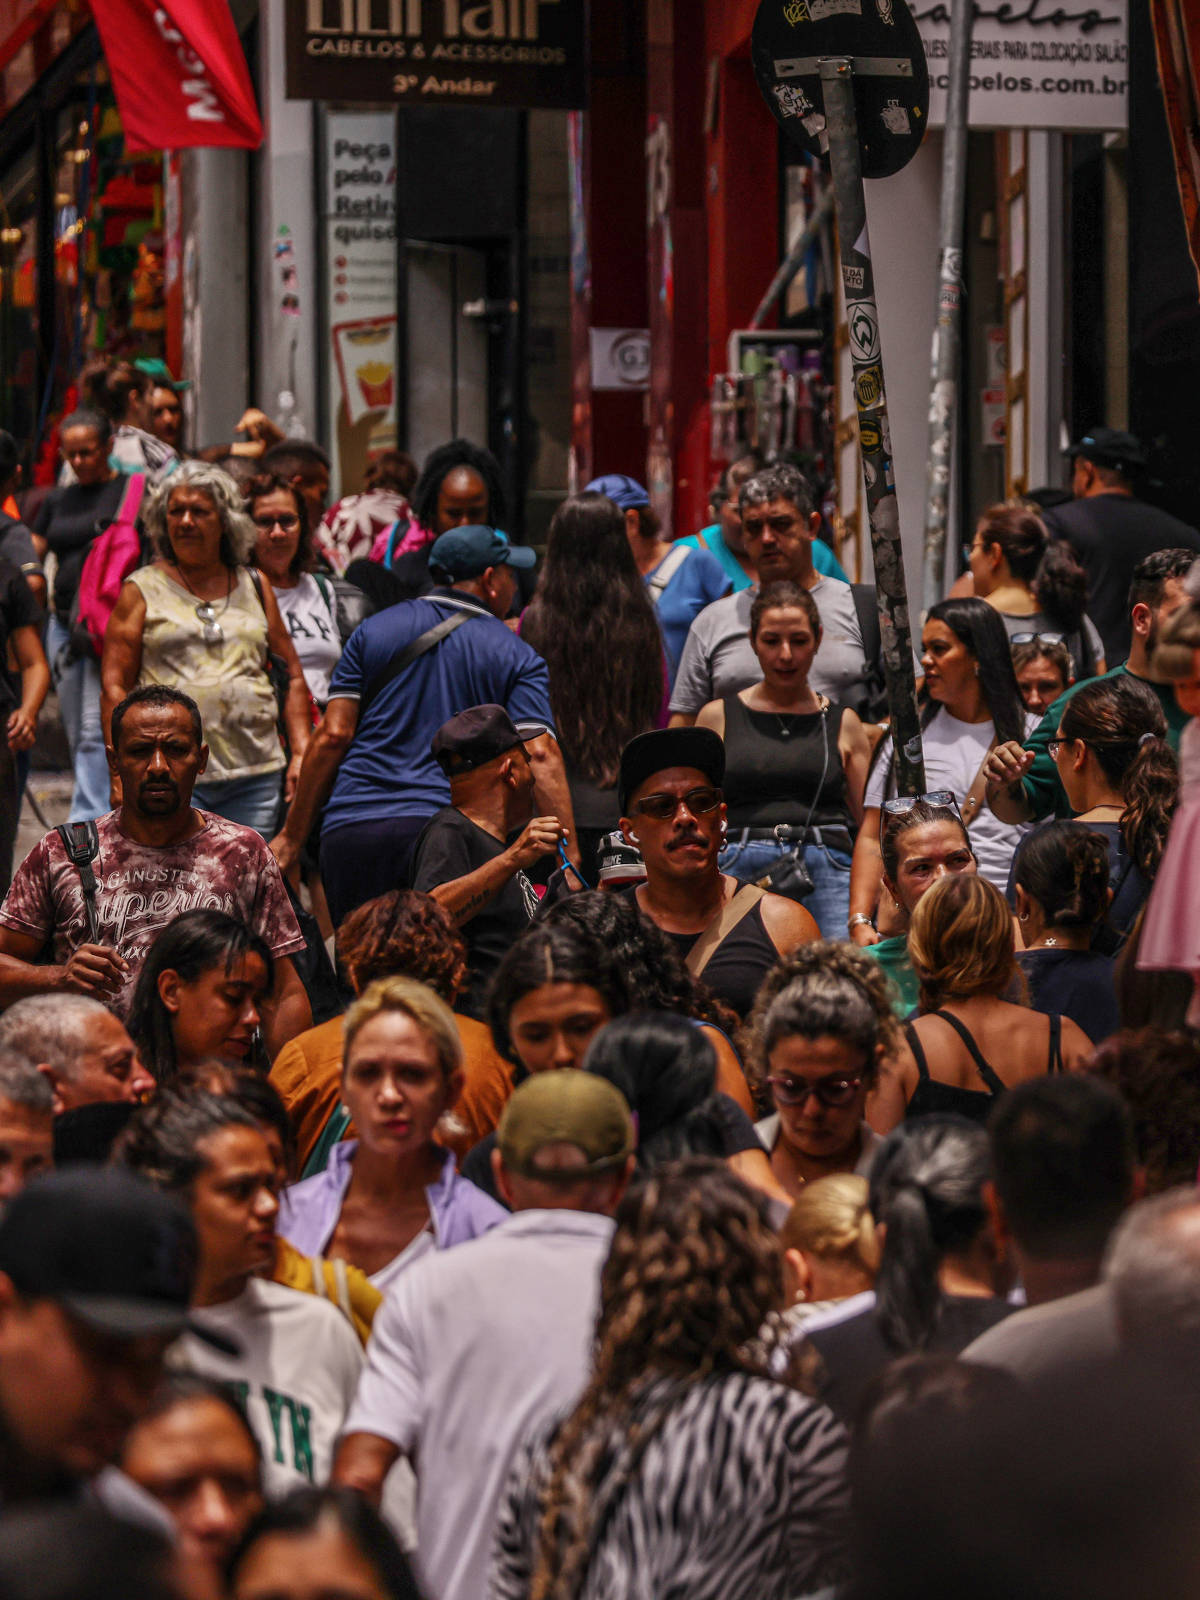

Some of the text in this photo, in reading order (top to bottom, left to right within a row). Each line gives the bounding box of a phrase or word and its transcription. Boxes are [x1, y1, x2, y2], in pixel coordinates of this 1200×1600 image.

[306, 38, 405, 57] CABELOS
[412, 42, 425, 59] &
[421, 75, 496, 96] Andar
[334, 139, 391, 164] Peça
[334, 165, 384, 189] pelo
